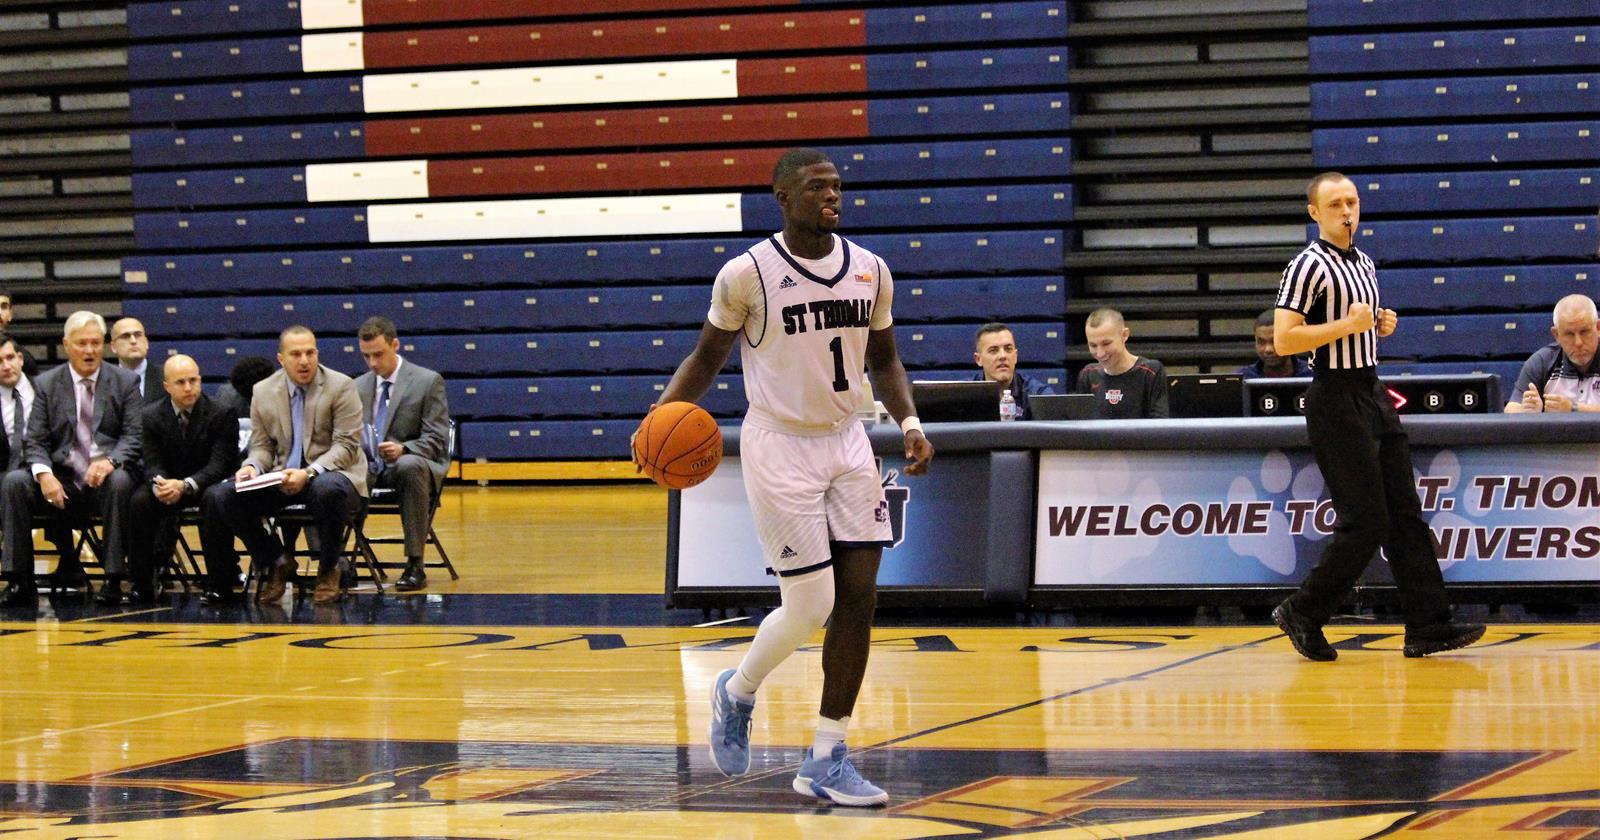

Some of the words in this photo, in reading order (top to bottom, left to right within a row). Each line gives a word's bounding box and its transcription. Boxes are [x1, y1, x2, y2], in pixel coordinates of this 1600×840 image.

[781, 303, 807, 335] ST
[829, 336, 849, 392] 1
[1264, 398, 1274, 410] B
[1429, 394, 1439, 406] B
[1464, 394, 1474, 405] B
[1048, 501, 1272, 537] WELCOME
[1286, 500, 1337, 536] TO
[1417, 477, 1455, 511] T.
[1429, 525, 1600, 560] NIVERS
